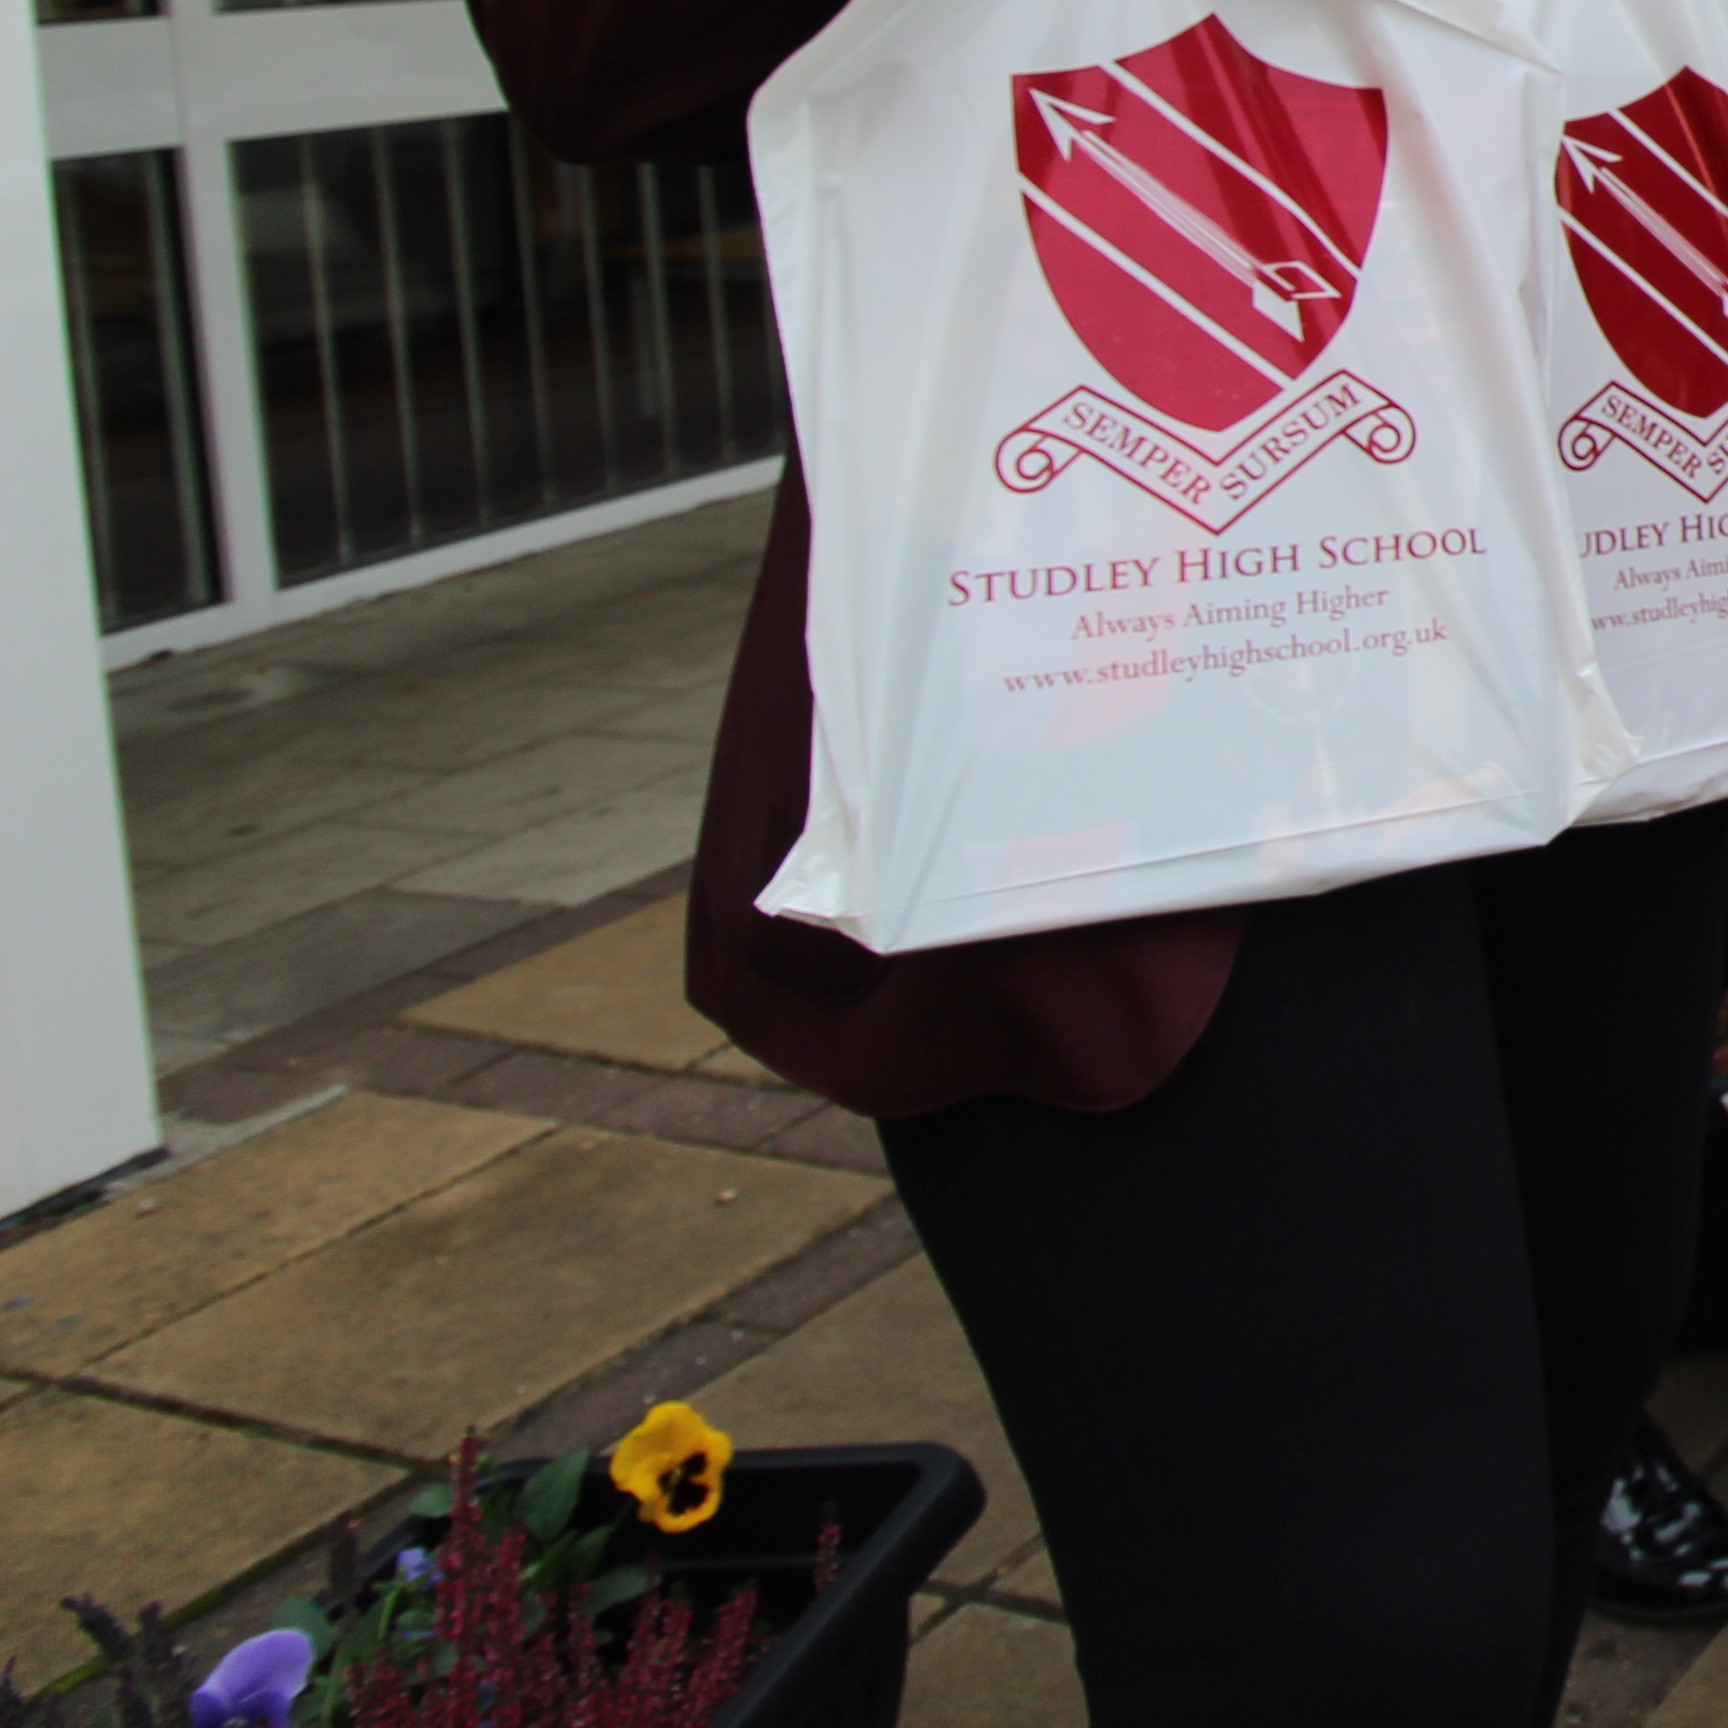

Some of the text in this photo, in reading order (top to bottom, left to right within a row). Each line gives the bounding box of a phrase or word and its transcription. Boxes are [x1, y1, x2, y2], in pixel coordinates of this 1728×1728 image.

[1062, 384, 1362, 506] SEMPER SURSUM
[1601, 394, 1702, 479] SEMPER
[947, 527, 1487, 607] STUDLEY HIGH SCHOOL
[1579, 521, 1671, 559] UDLEY
[1613, 566, 1682, 592] Always
[1071, 586, 1390, 646] Always Aiming Higher
[1002, 617, 1449, 695] www.studleyhighschool.org.uk
